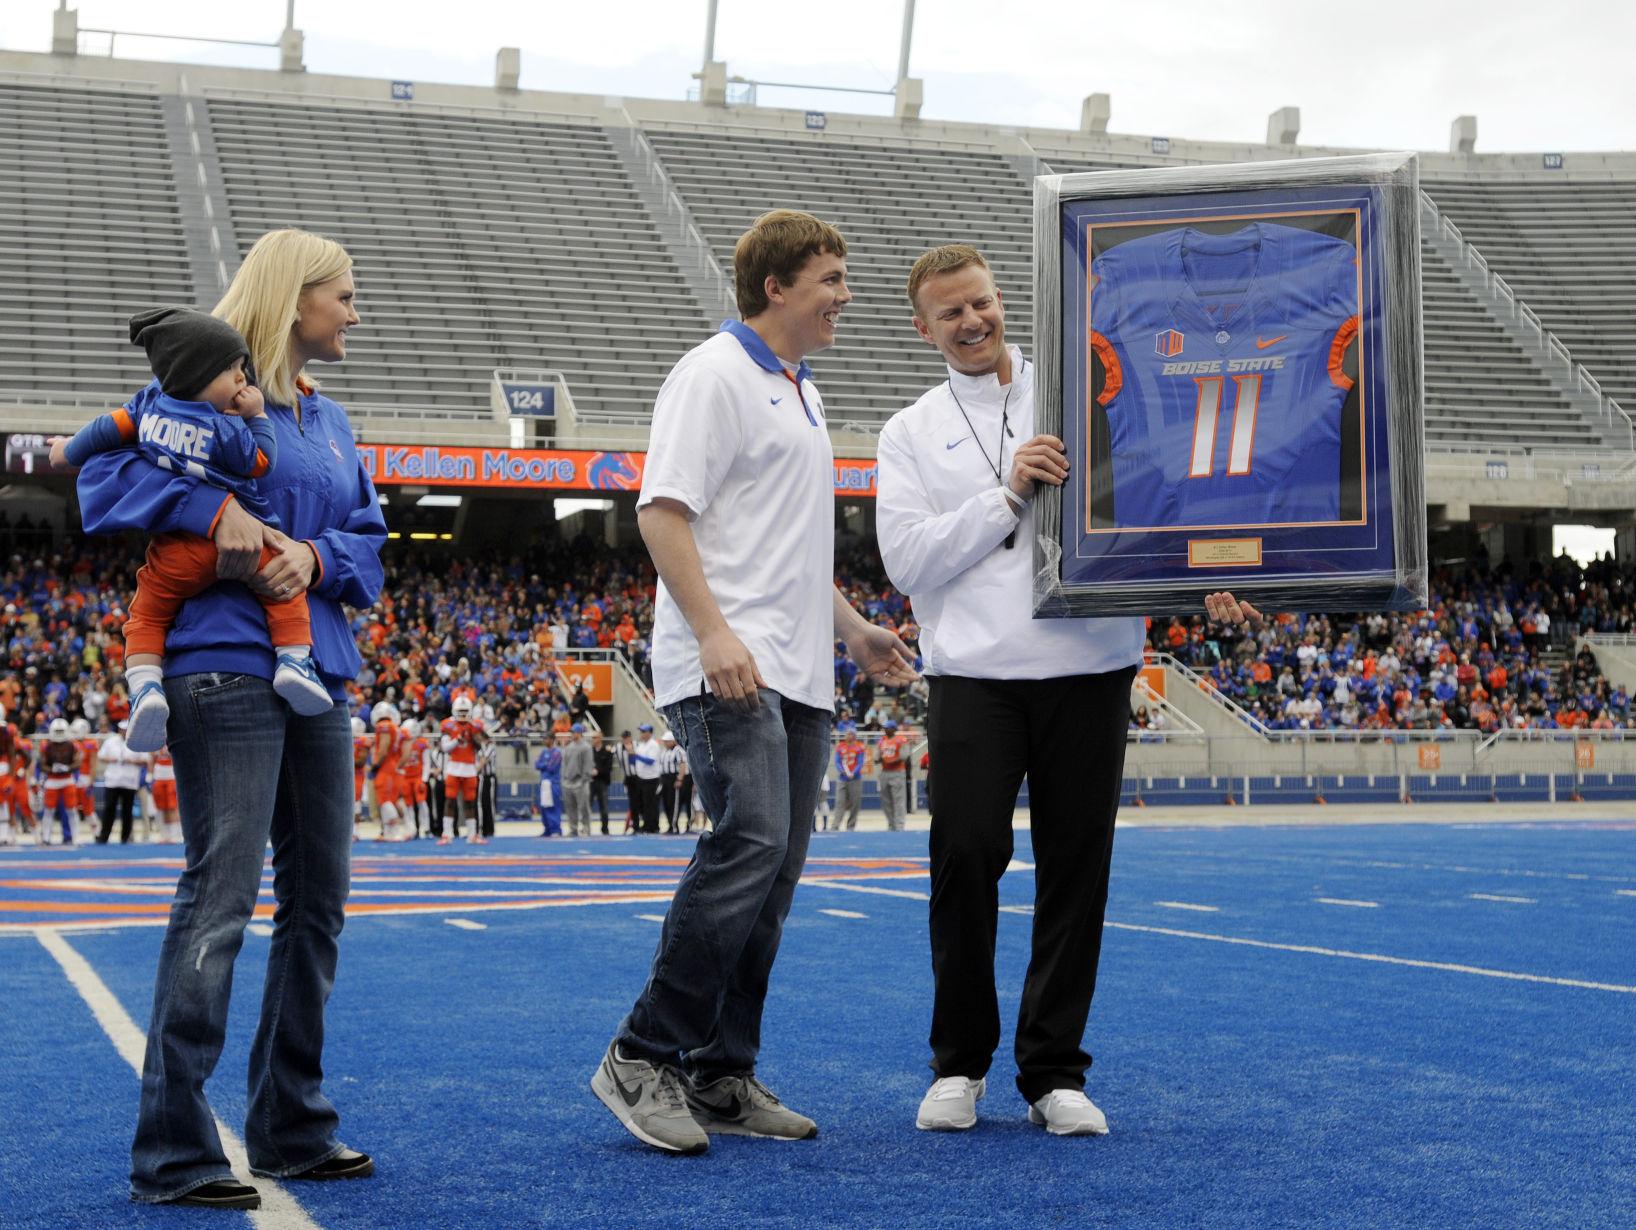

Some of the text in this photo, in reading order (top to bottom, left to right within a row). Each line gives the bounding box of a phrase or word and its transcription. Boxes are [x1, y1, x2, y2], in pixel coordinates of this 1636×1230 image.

[1162, 356, 1287, 376] BOISE STATE
[510, 391, 544, 410] 124
[139, 413, 214, 461] MOORE
[1188, 374, 1263, 480] 11
[22, 452, 34, 474] 1
[384, 447, 475, 478] Kellen
[482, 450, 574, 482] Moore
